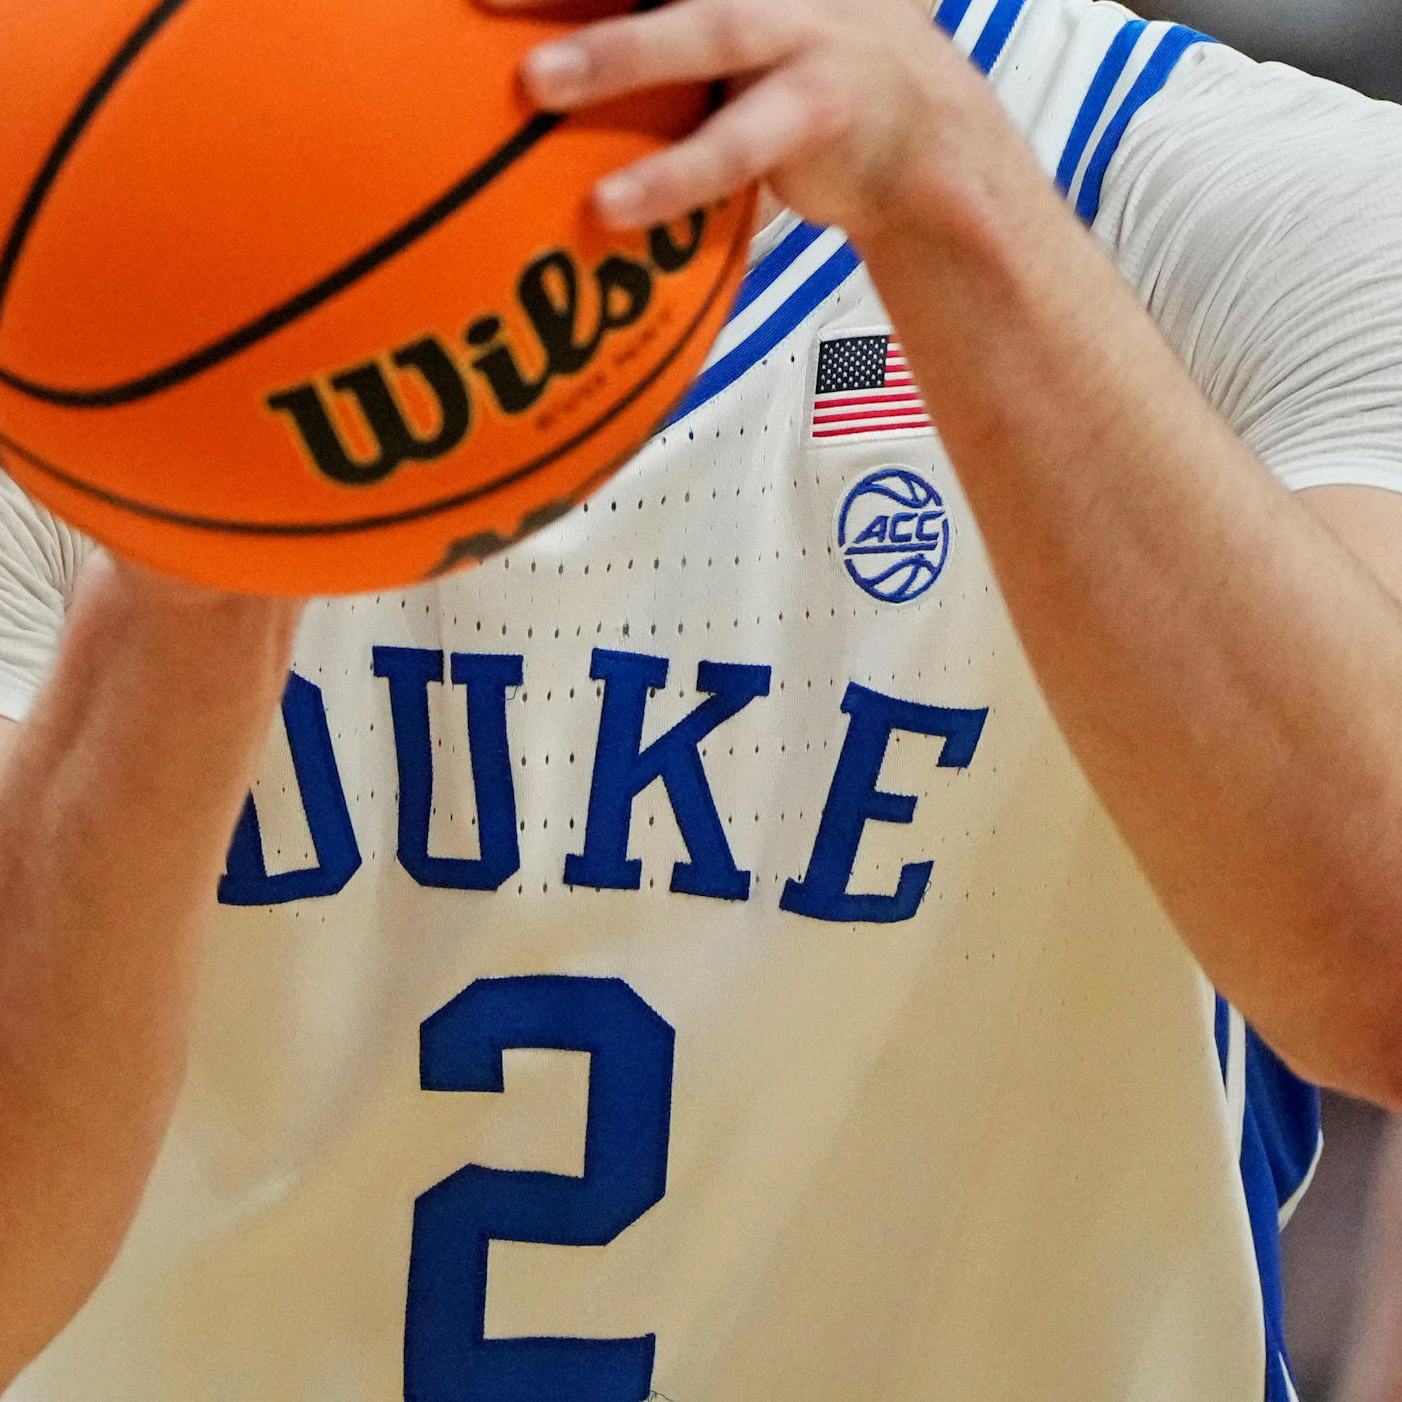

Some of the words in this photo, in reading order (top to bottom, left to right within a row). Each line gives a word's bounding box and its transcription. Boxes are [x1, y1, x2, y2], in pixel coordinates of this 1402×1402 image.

[265, 202, 723, 487] Wilso
[853, 510, 945, 544] ACC
[217, 645, 989, 923] DUKE
[403, 974, 676, 1402] 2
